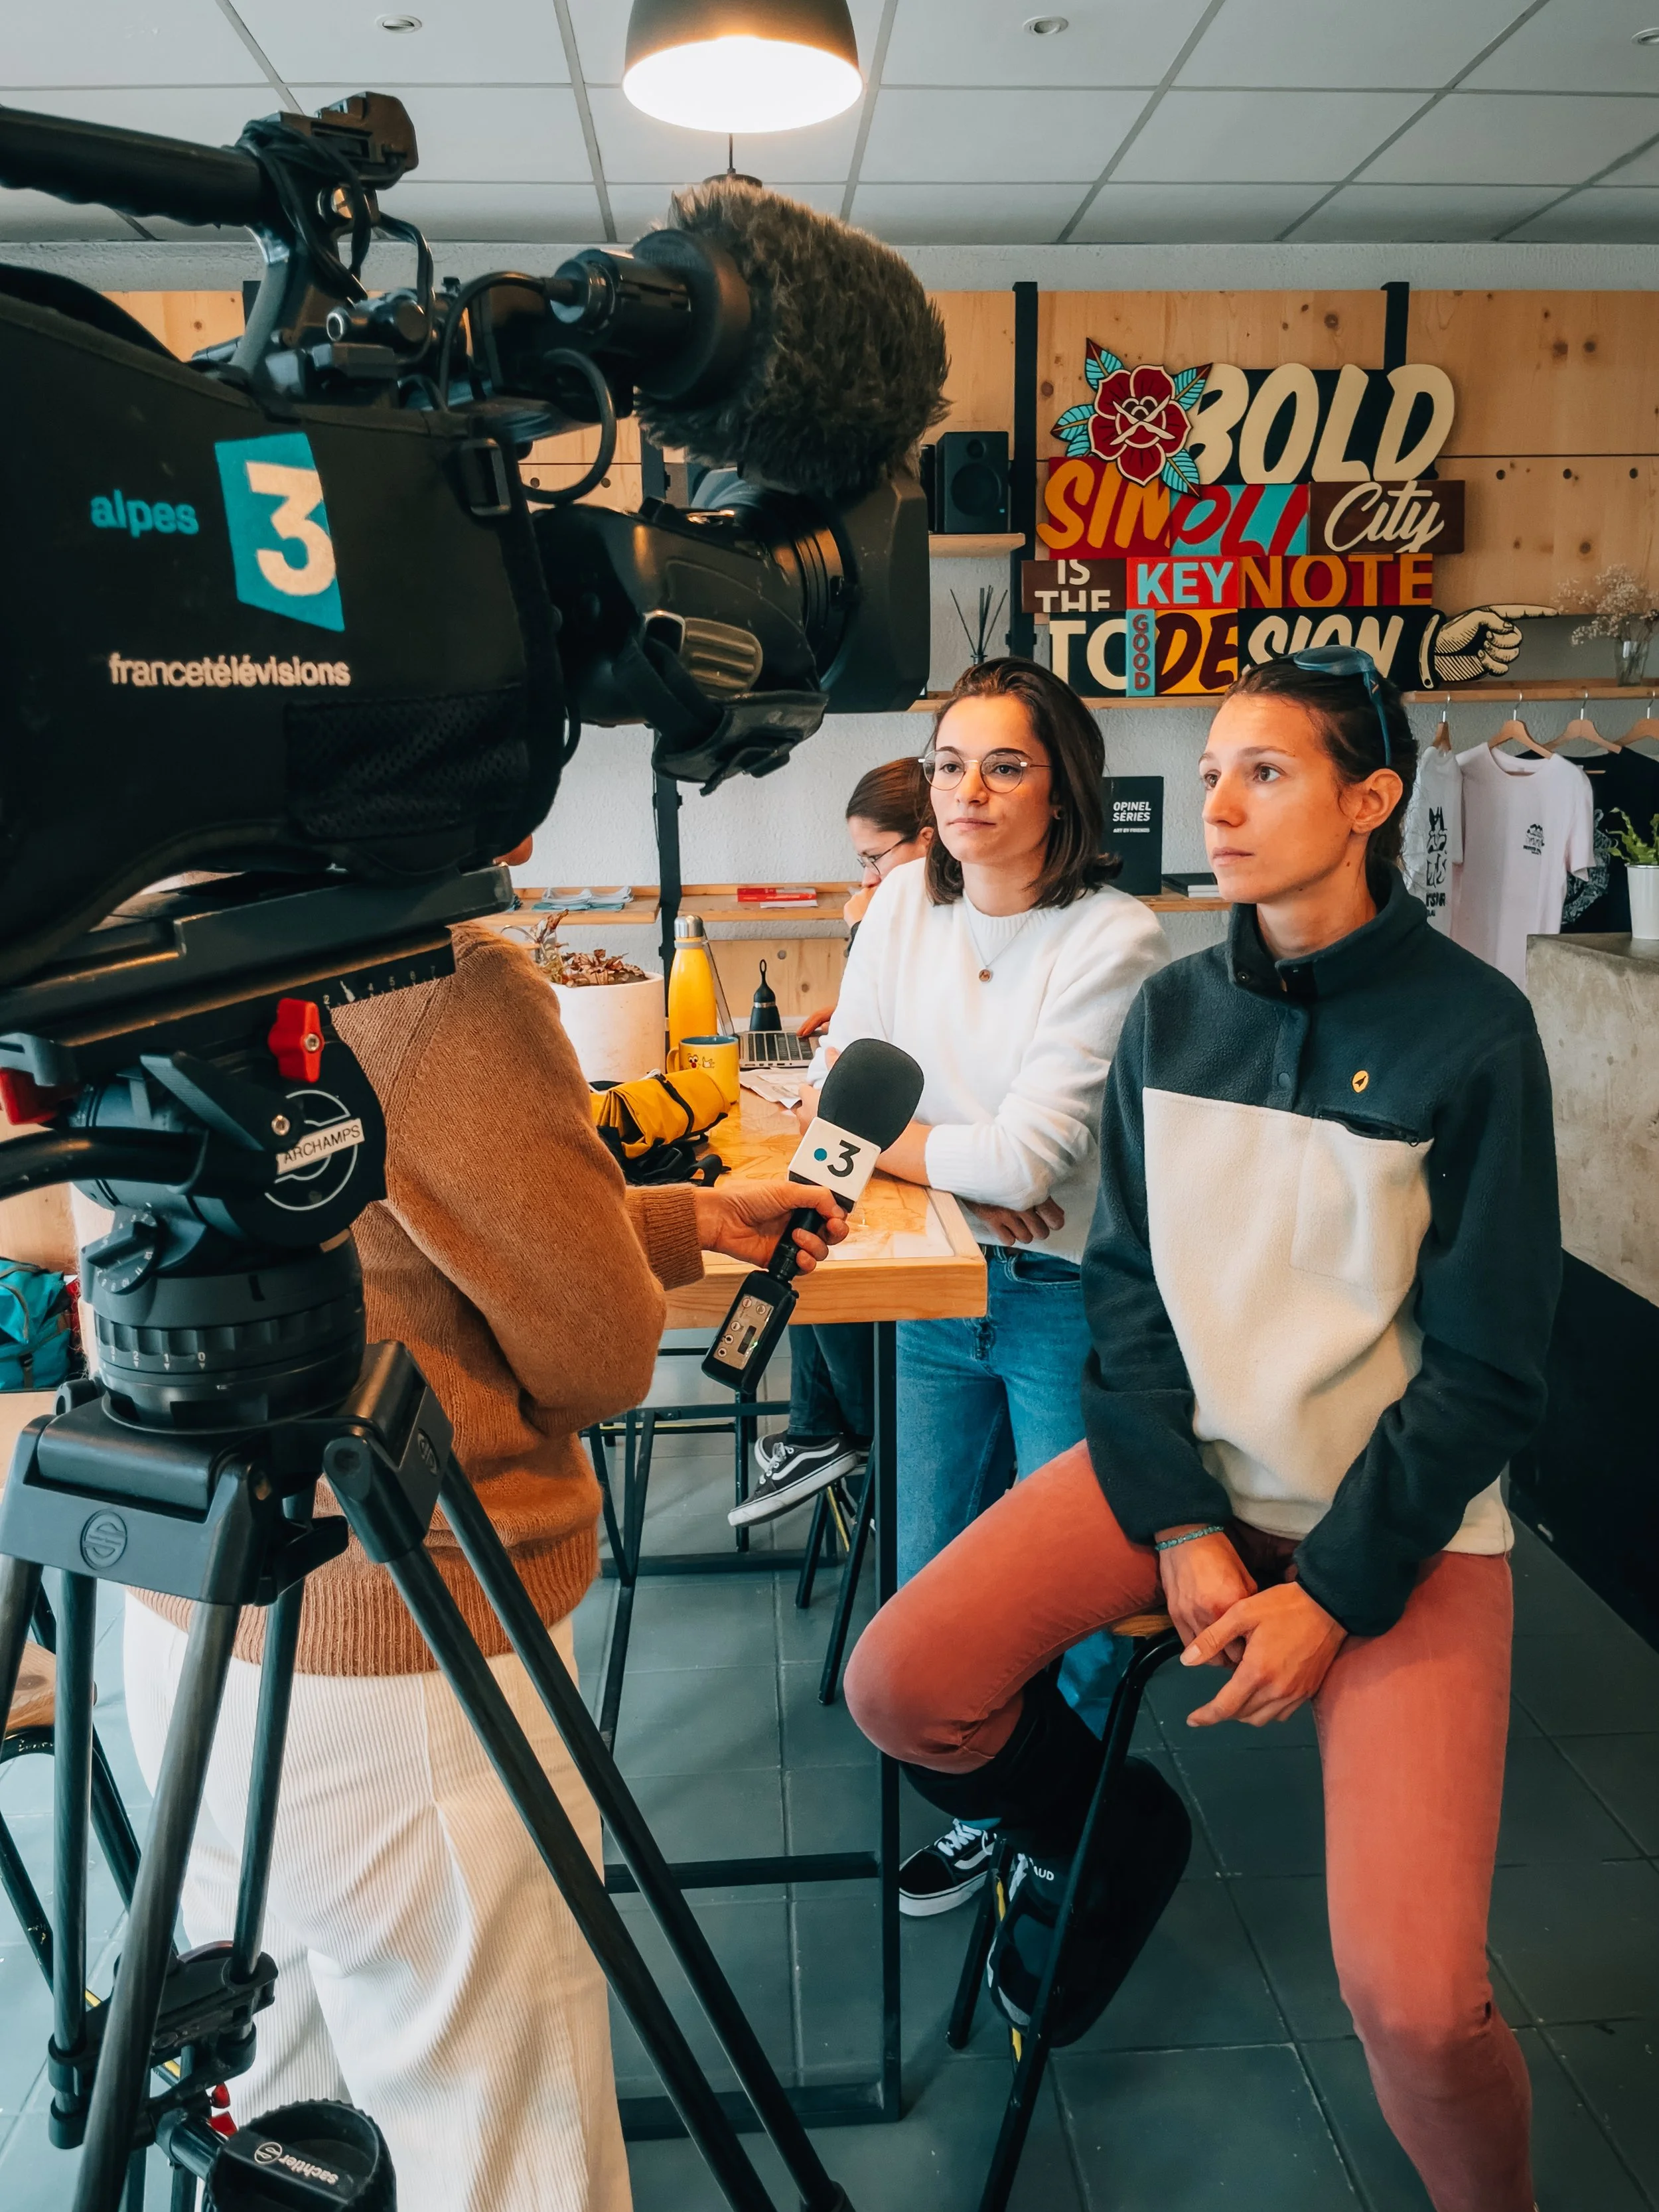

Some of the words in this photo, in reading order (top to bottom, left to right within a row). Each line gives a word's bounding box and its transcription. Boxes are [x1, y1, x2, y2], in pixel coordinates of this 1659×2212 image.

[1188, 363, 1455, 484] BOLD
[90, 489, 198, 537] alpes
[245, 461, 336, 597] 3
[1057, 559, 1090, 585] IS
[1035, 590, 1111, 612] THE
[108, 652, 351, 687] francetélévisions
[1132, 614, 1150, 690] GOOD
[1113, 801, 1151, 811] OPINEL
[284, 1124, 361, 1164] ARCHAMPS
[827, 1140, 861, 1177] 3
[133, 1351, 139, 1361] 2
[164, 1353, 169, 1362] 1
[198, 1351, 206, 1361] 0
[279, 2154, 338, 2185] sachtler
